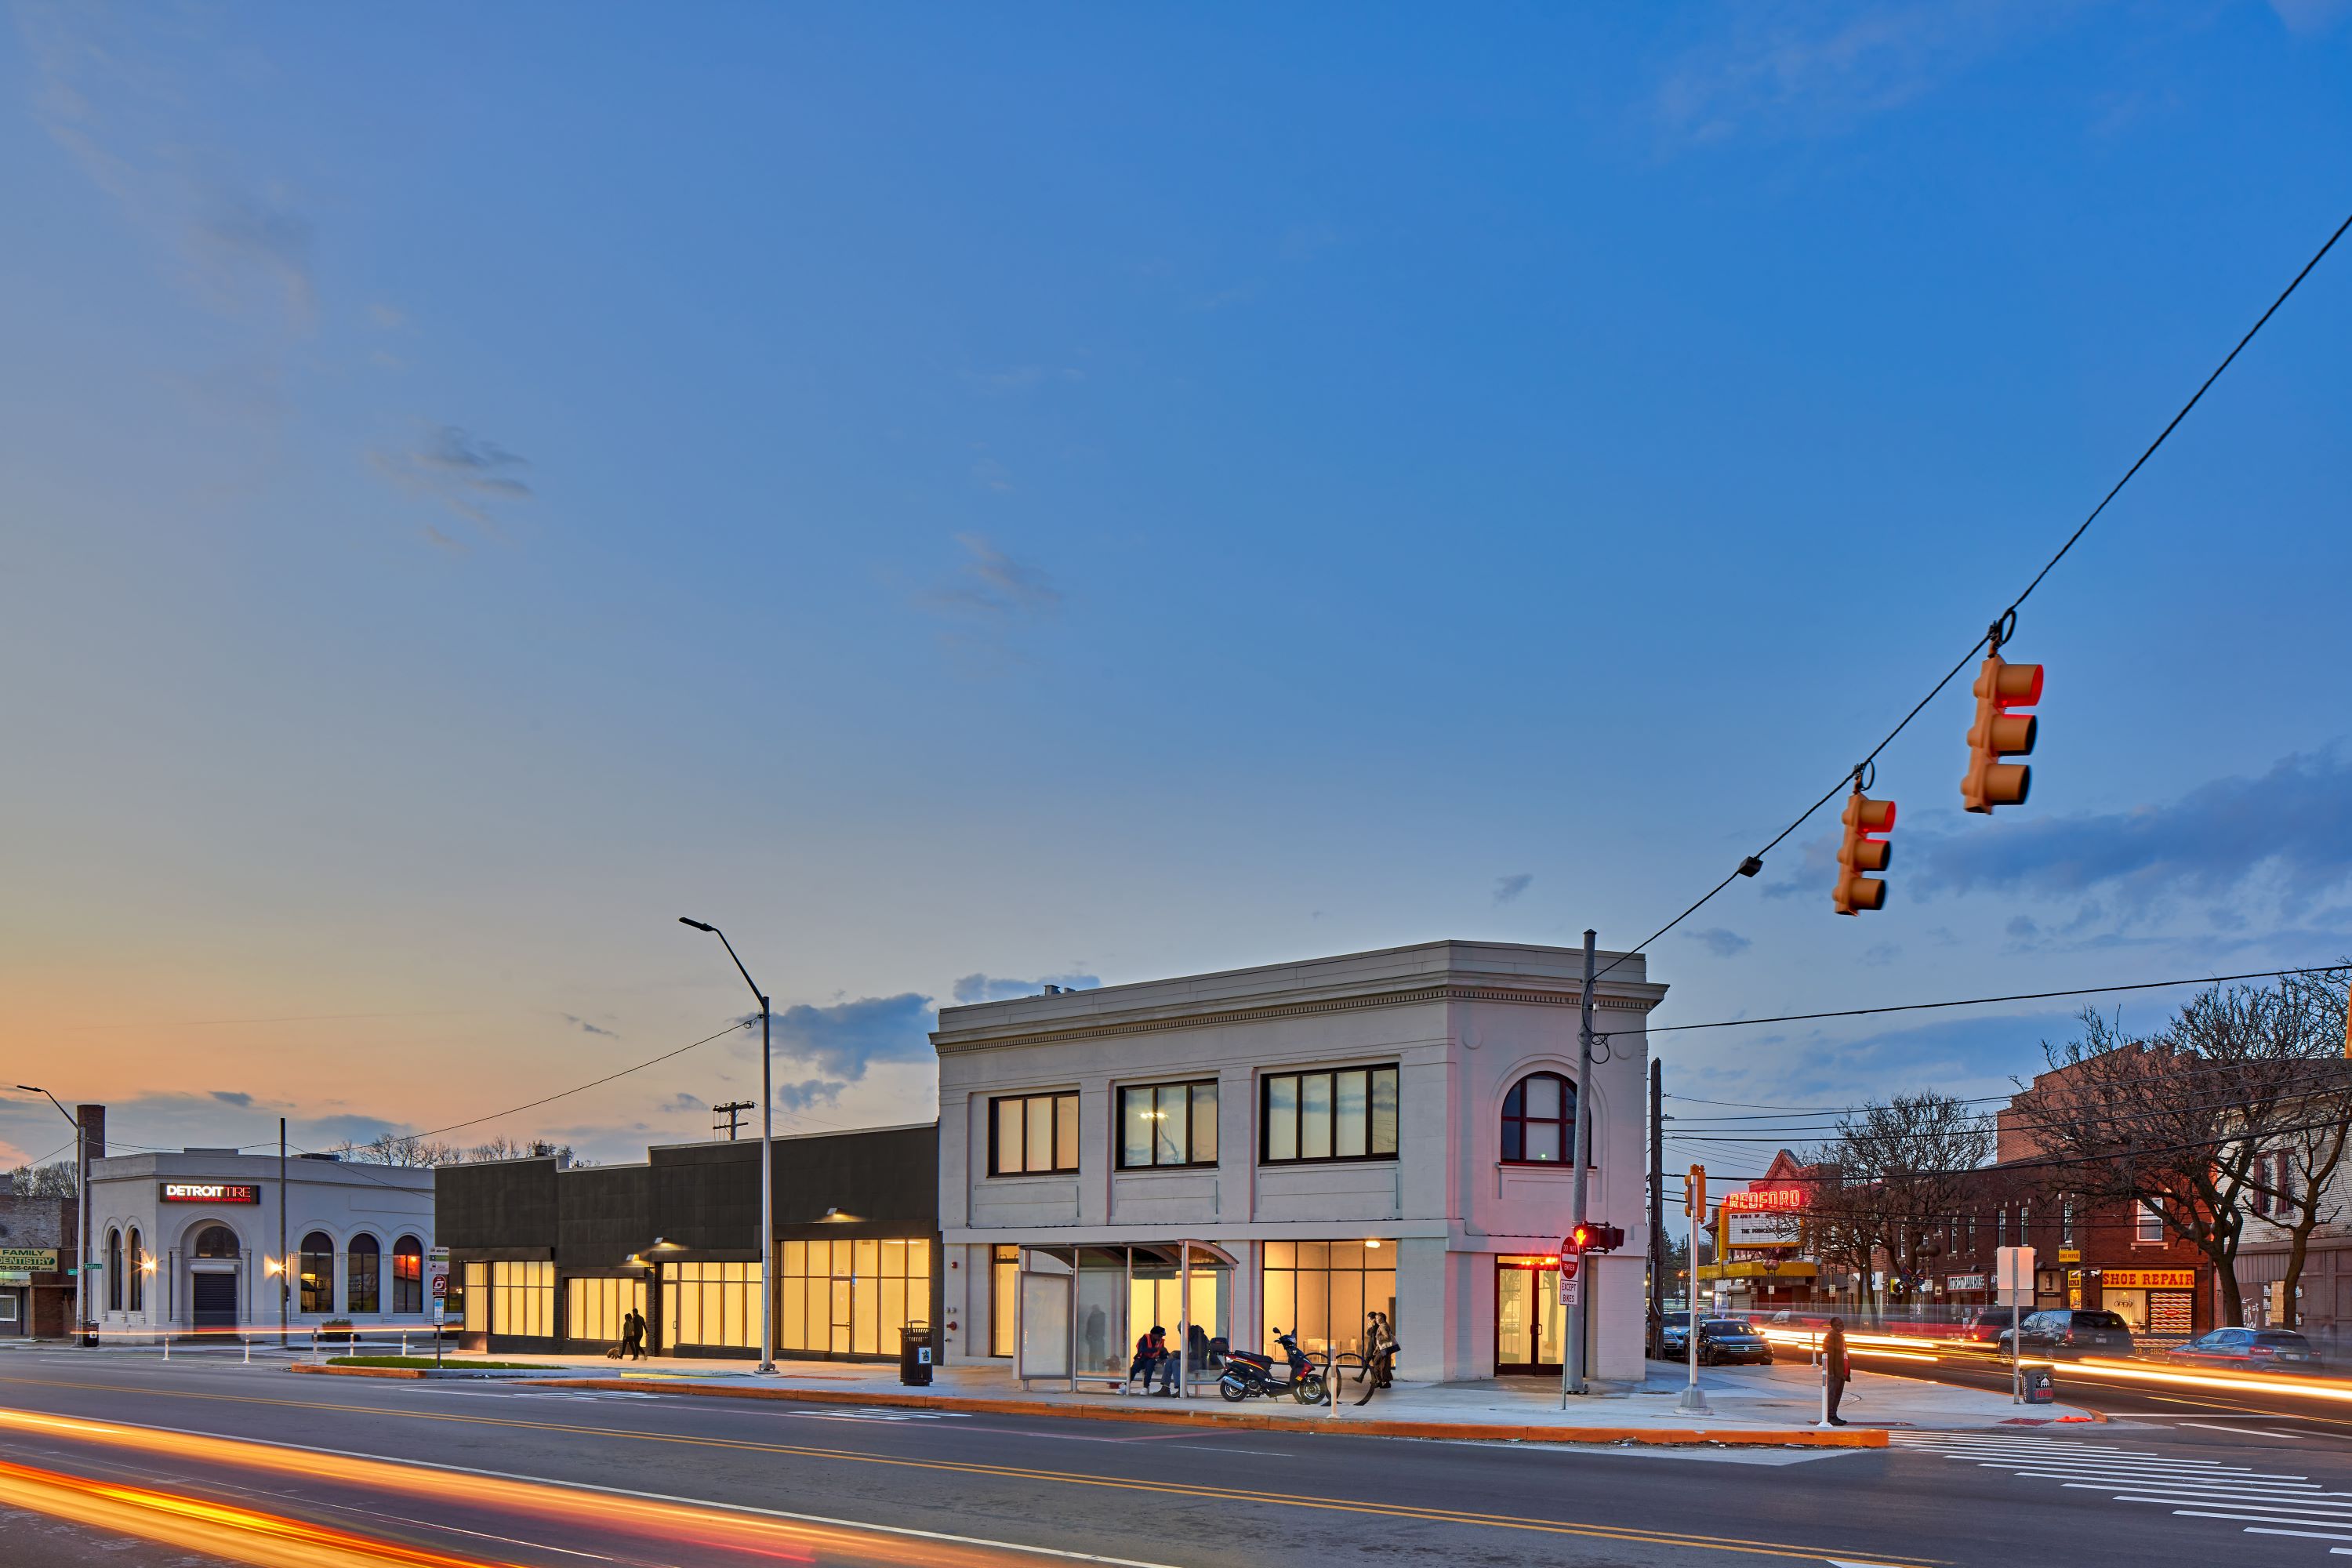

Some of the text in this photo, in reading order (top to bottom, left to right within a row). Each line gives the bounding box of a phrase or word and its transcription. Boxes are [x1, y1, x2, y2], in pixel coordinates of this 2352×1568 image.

[166, 1185, 251, 1198] DETROIT TIRE
[1730, 1190, 1800, 1209] REDFORD
[2103, 1273, 2194, 1285] SHOE REPAIR
[1562, 1283, 1577, 1291] EXCEPT
[1563, 1294, 1575, 1303] BIKES
[2114, 1300, 2133, 1308] OPEN
